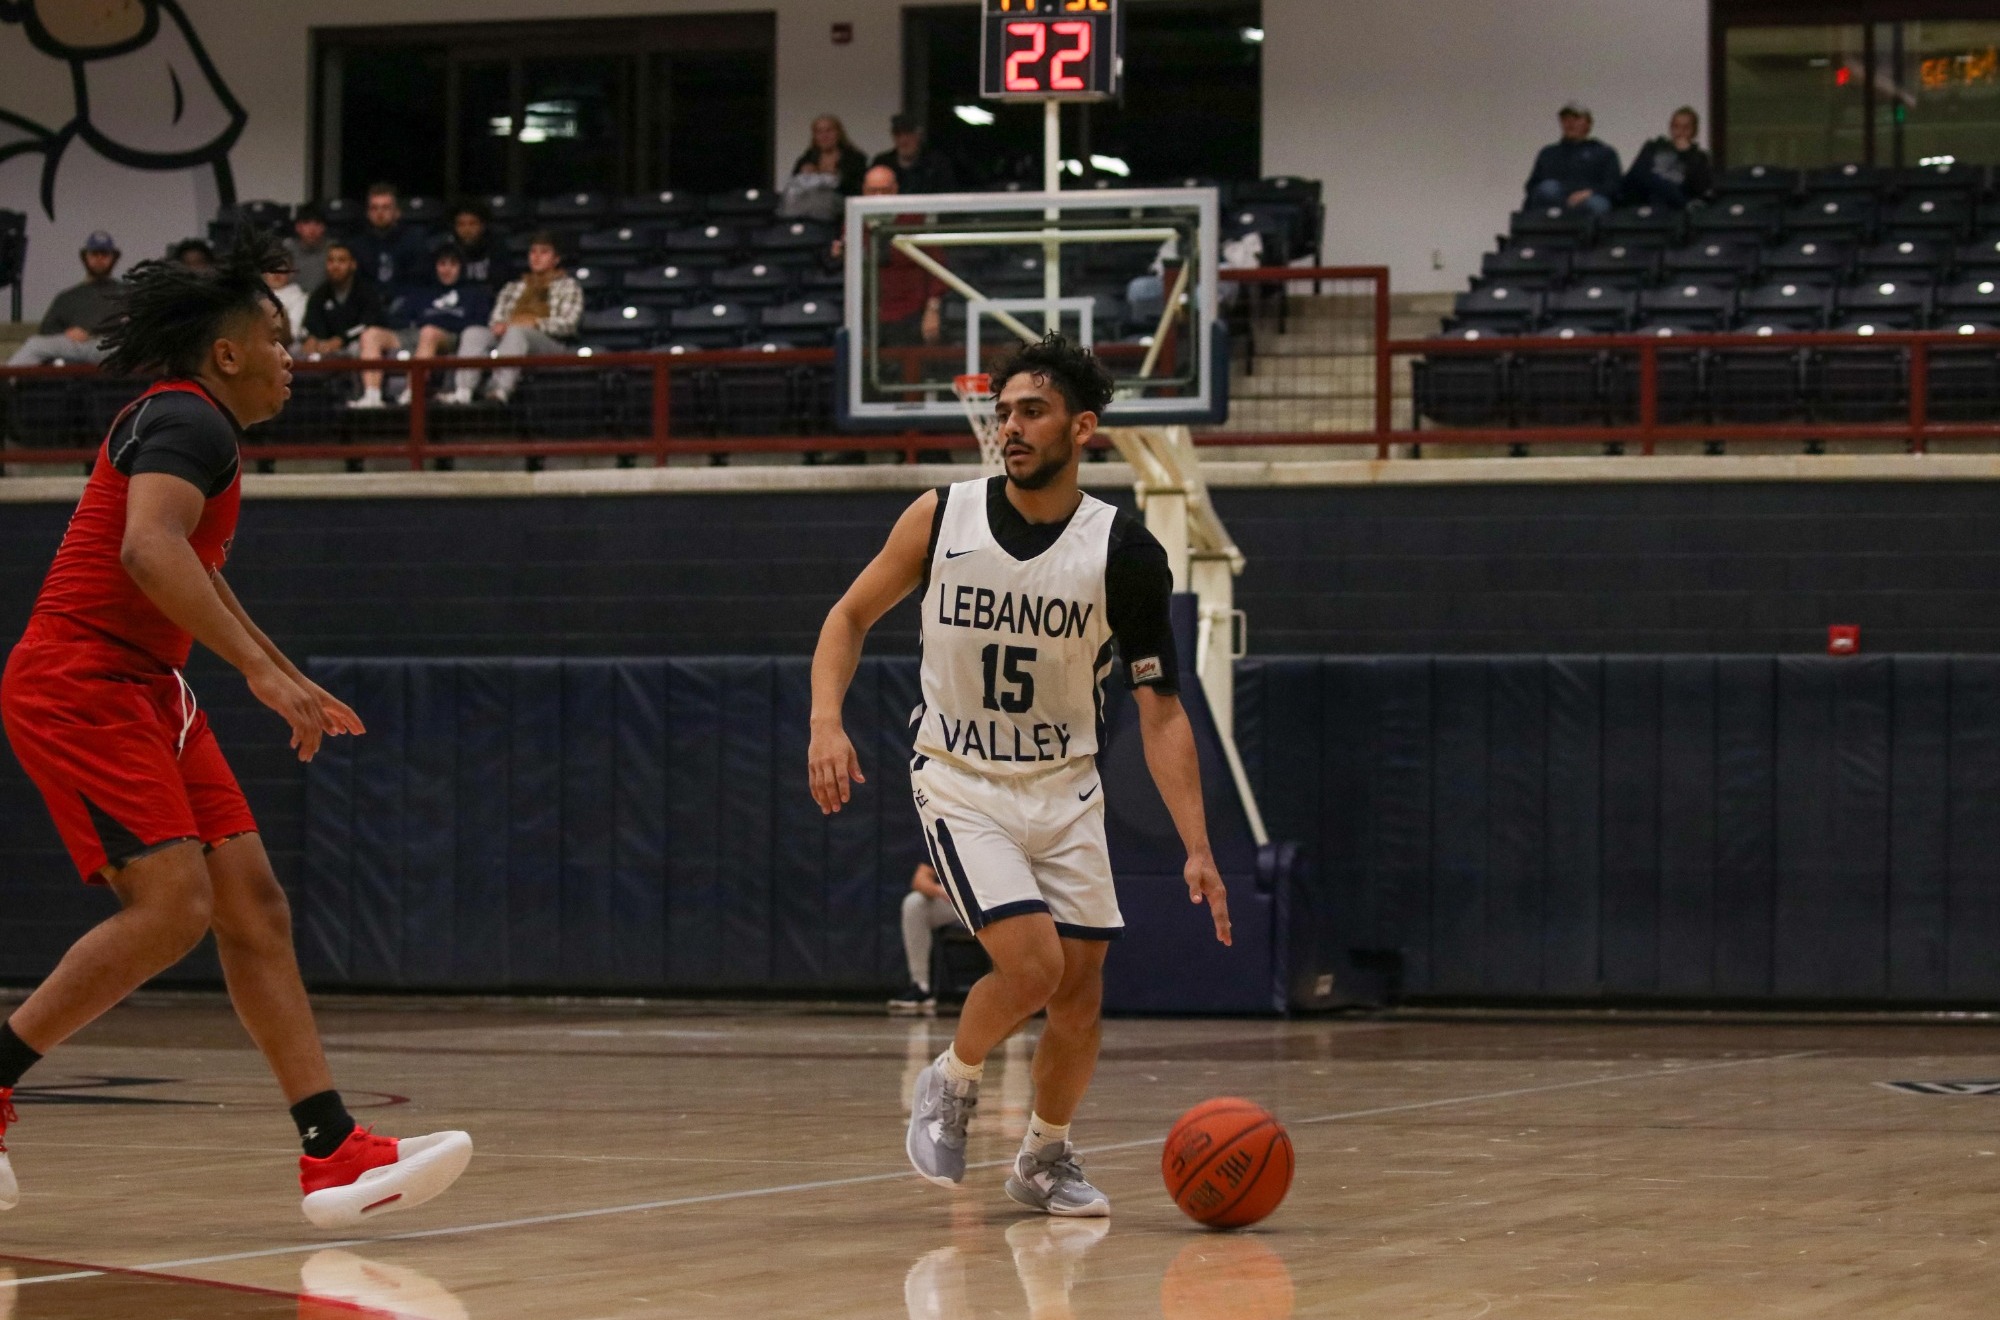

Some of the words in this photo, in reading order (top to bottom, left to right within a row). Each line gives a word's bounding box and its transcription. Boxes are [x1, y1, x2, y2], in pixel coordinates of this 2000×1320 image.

[1006, 22, 1090, 91] 22
[939, 583, 1093, 638] LEBANON
[981, 643, 1037, 713] 15
[939, 713, 1070, 761] VALLEY
